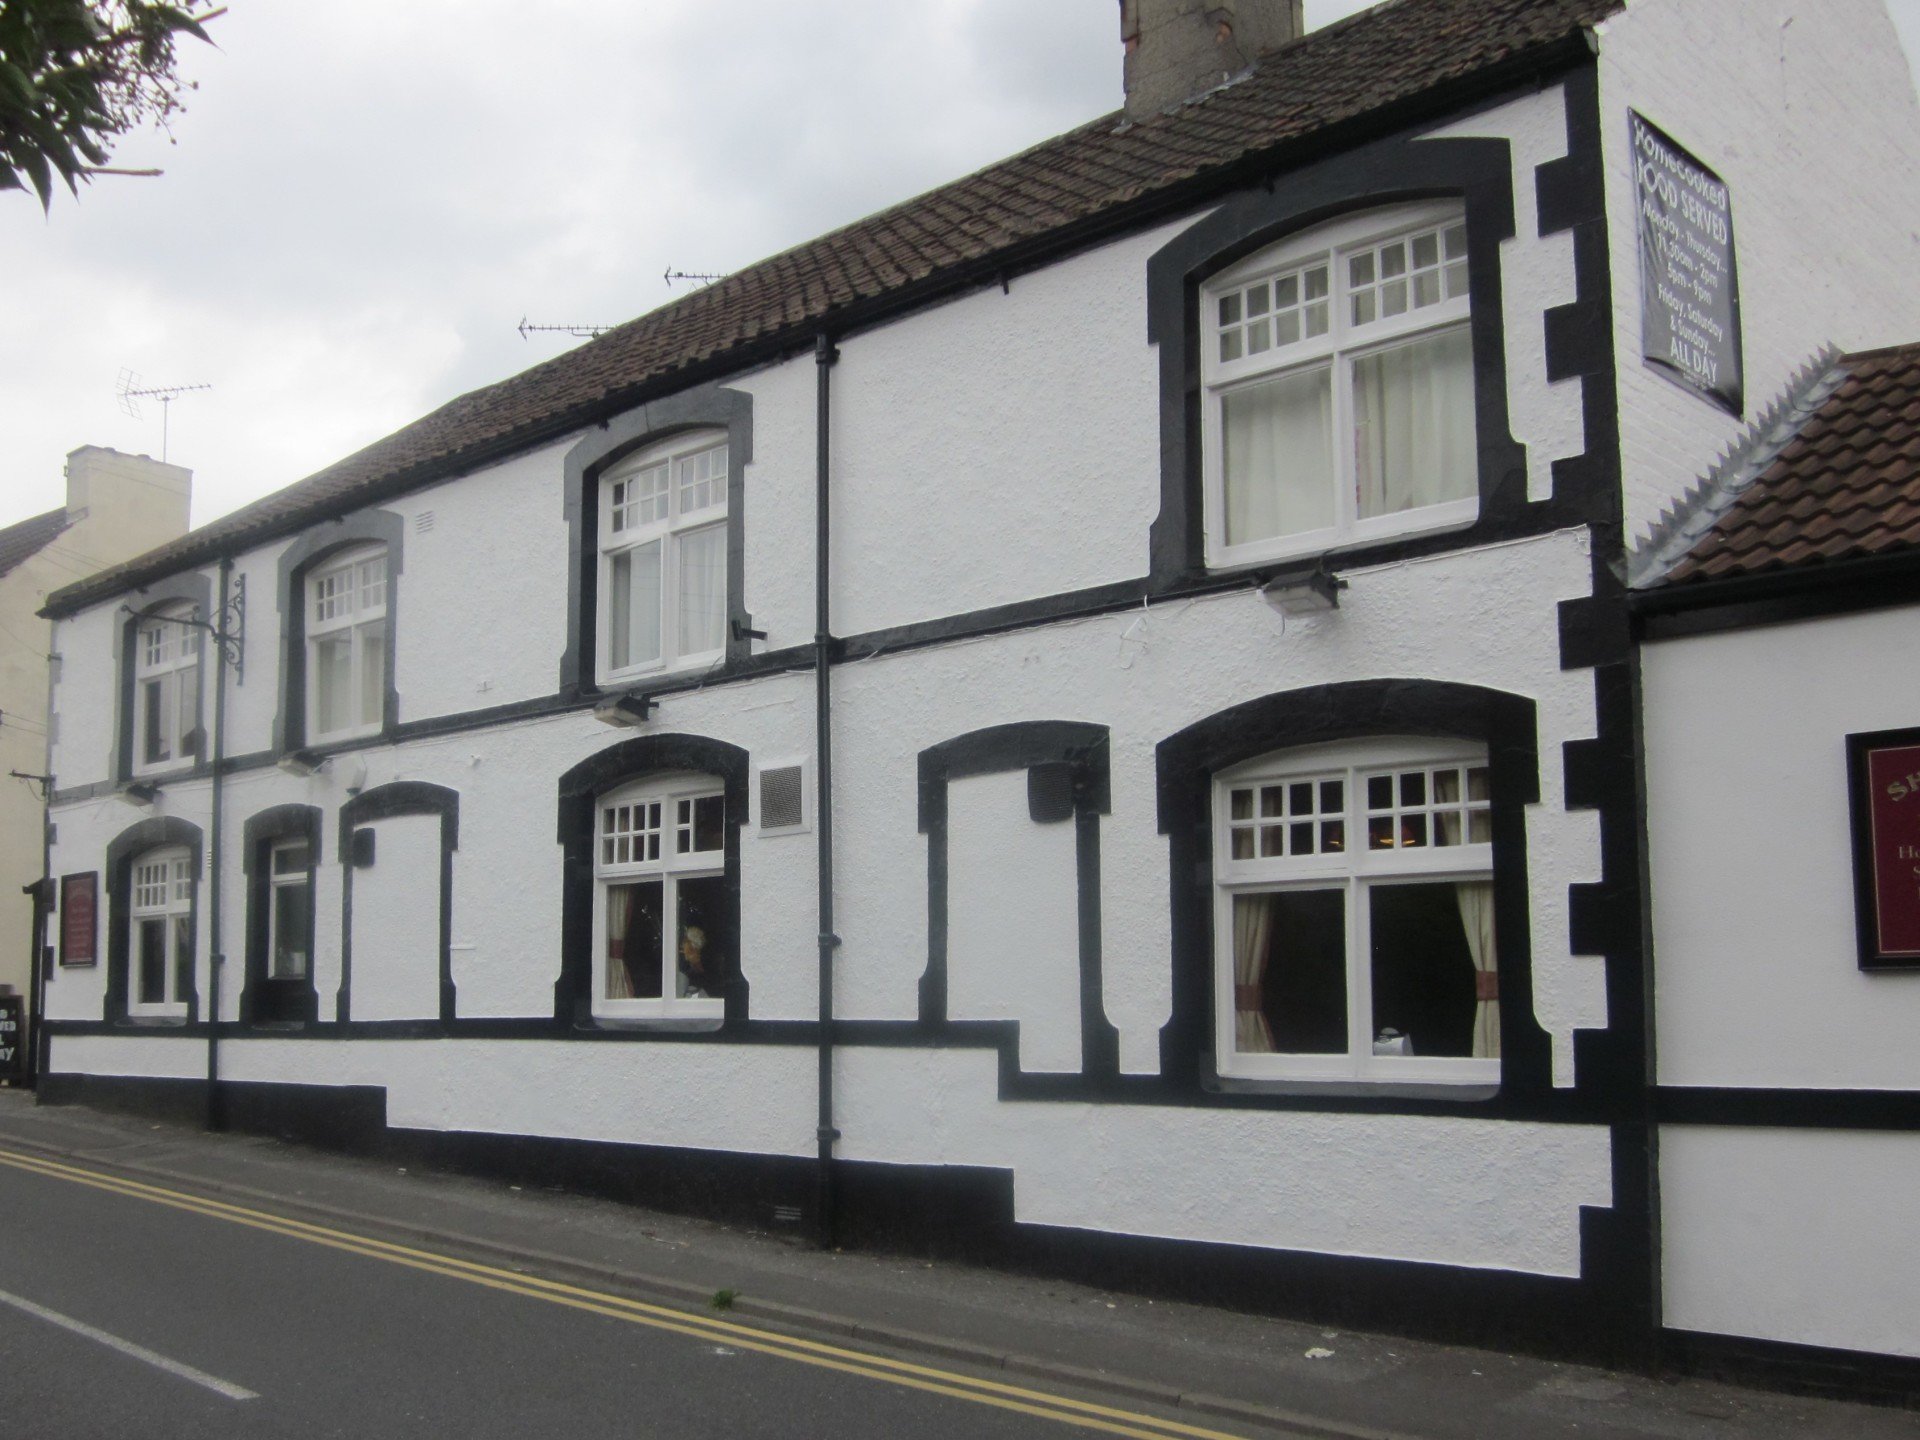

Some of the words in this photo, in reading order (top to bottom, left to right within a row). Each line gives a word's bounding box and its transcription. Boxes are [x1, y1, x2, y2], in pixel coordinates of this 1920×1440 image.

[1634, 119, 1726, 211] Homecooked
[1681, 189, 1727, 246] SERVED
[1670, 336, 1691, 367] ALL
[1693, 349, 1717, 383] DAY
